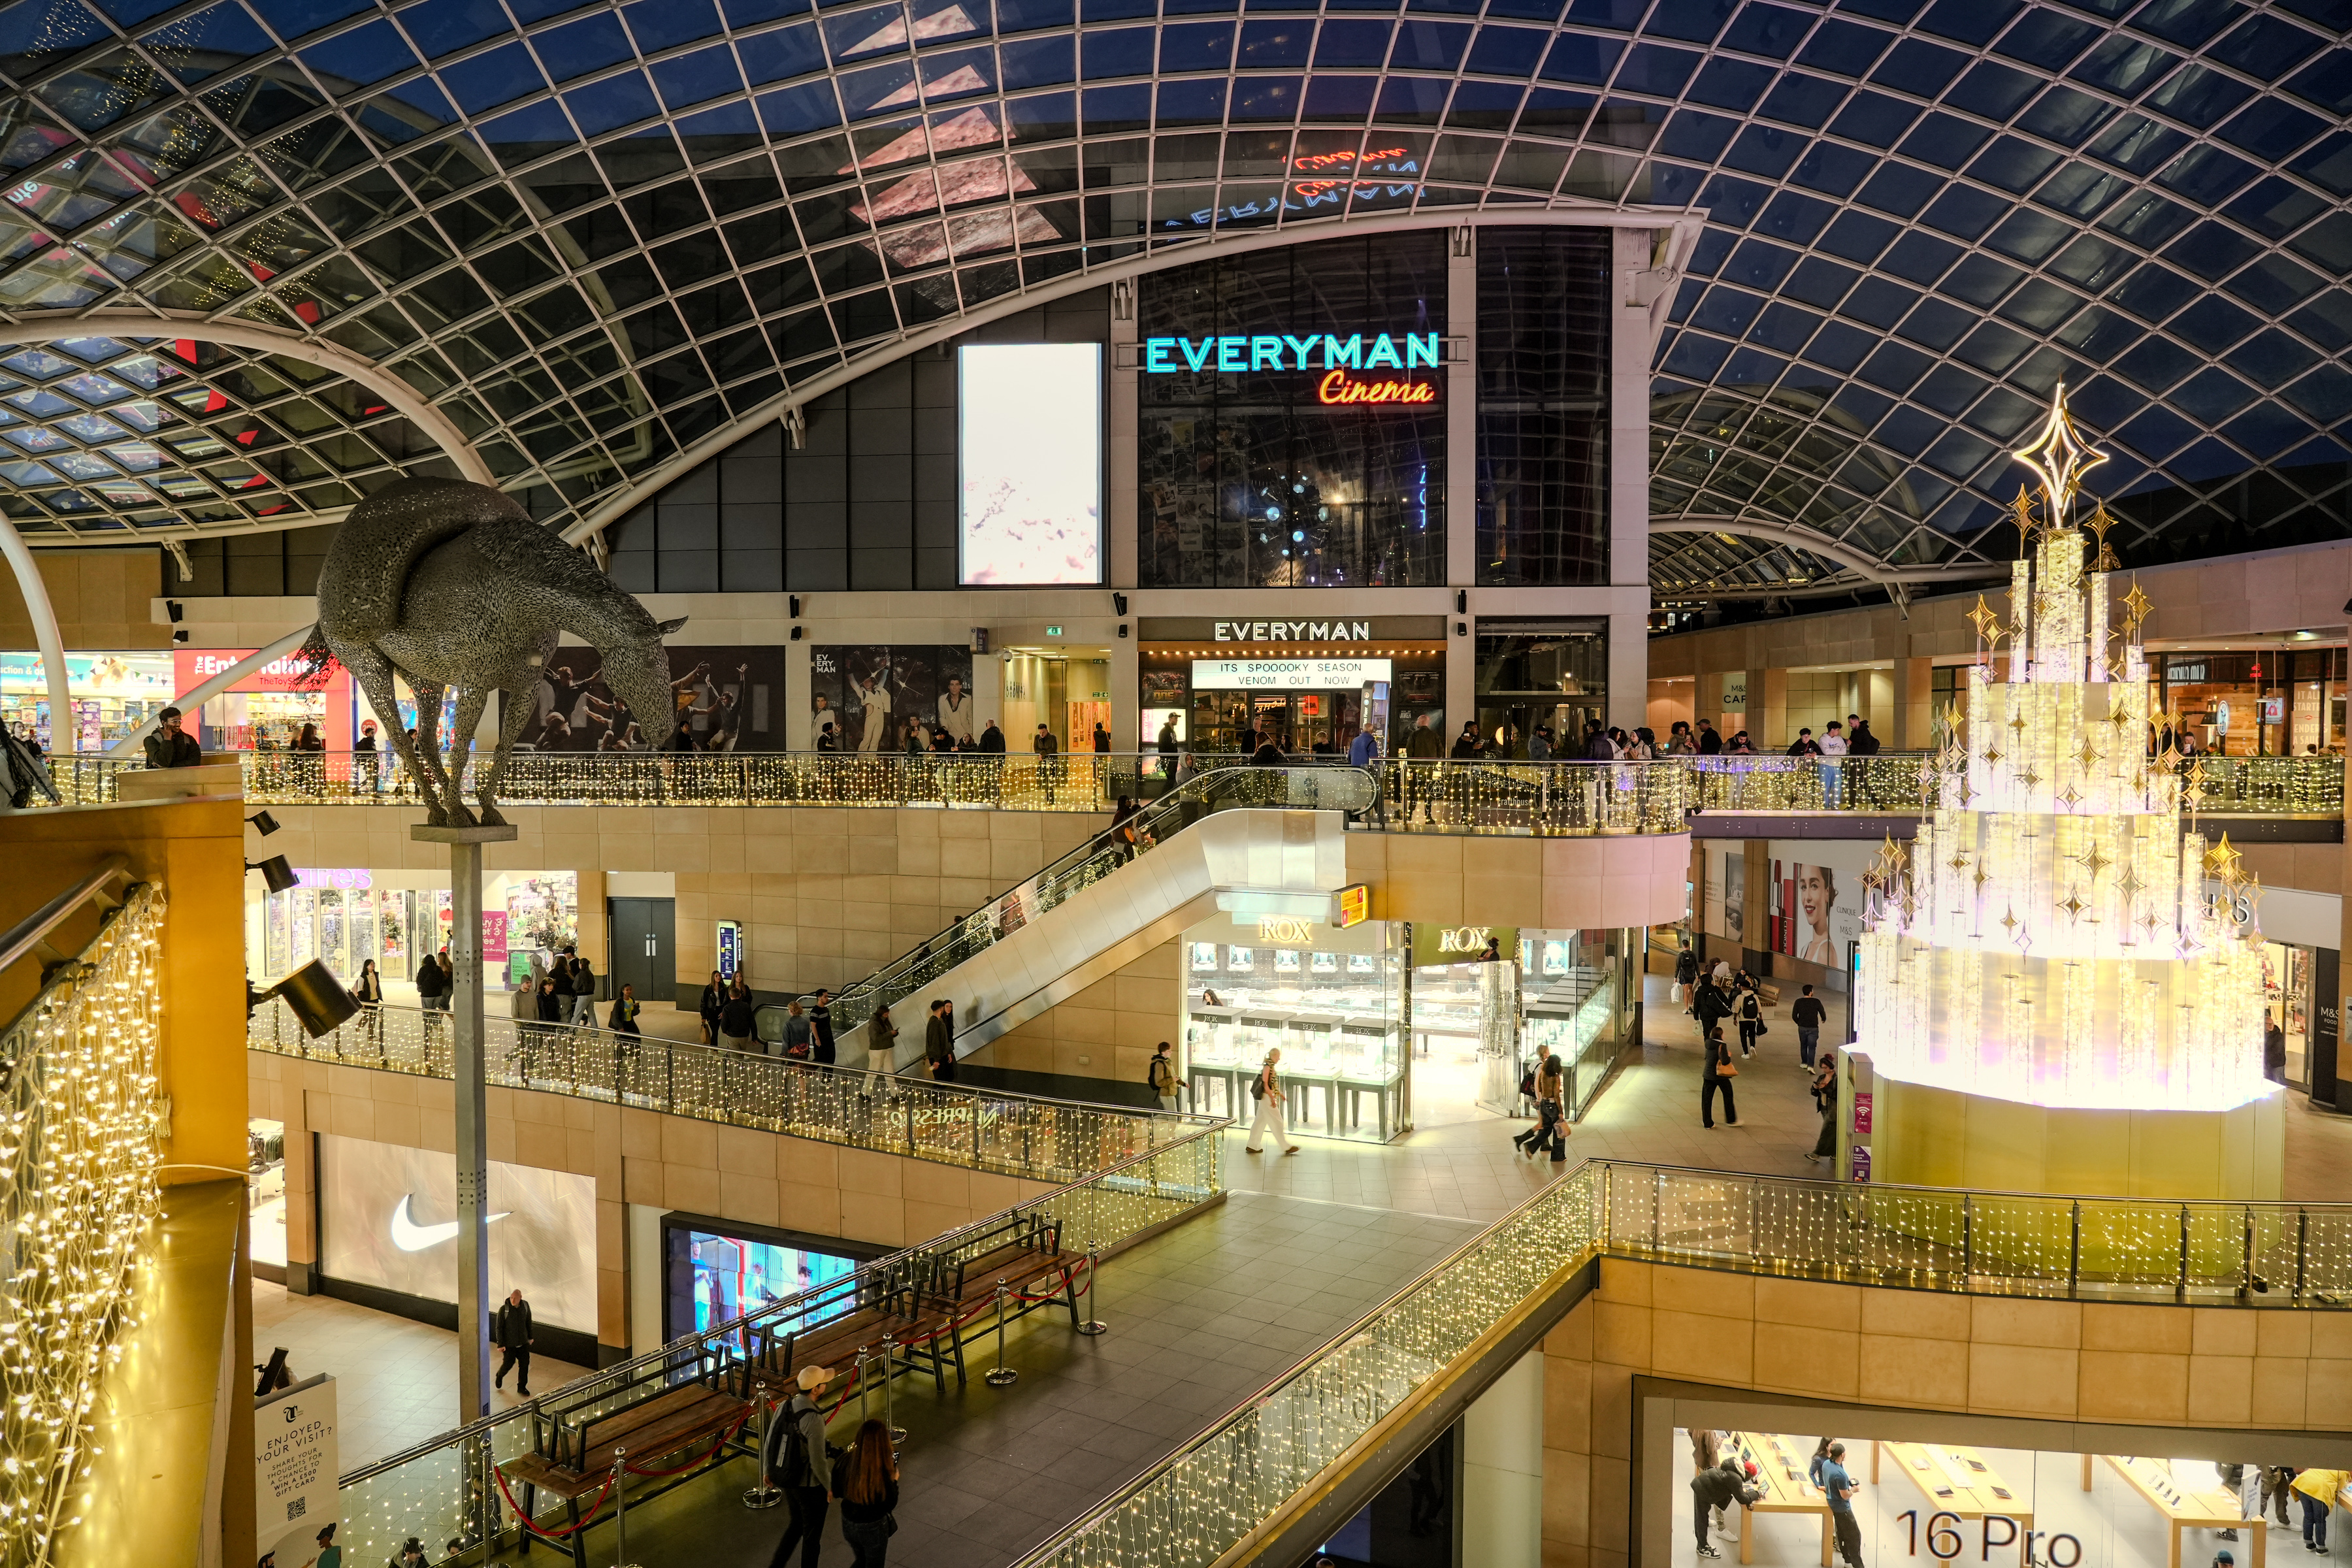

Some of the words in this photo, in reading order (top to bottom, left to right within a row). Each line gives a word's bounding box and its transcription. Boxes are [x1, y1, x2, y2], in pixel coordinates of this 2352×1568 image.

[1146, 332, 1438, 373] EVERYMAN
[1319, 370, 1435, 404] Cinema
[1215, 622, 1369, 641] EVERYMAN
[195, 656, 203, 674] The
[205, 655, 321, 674] Entaine
[1220, 664, 1238, 672] ITS
[1248, 663, 1309, 672] SPOOOOKY
[1317, 663, 1362, 672] SEASON
[1238, 676, 1277, 685] VENOM
[1289, 676, 1311, 685] OUT
[1324, 676, 1350, 685] NOW
[1154, 691, 1174, 700] ONE
[1723, 695, 1746, 704] CAF
[2298, 691, 2305, 700] IT
[2294, 702, 2326, 711] STARTE
[2294, 724, 2319, 733] ENDER
[2300, 736, 2320, 745] SAUC
[292, 868, 371, 889] aire's
[1837, 906, 1857, 916] CLINIQUE
[496, 917, 502, 926] 3
[494, 927, 501, 936] 3
[1259, 917, 1313, 943] ROX
[1840, 926, 1853, 936] M&S
[1437, 926, 1494, 953] ROX
[1204, 1015, 1218, 1023] ROX
[1254, 1019, 1268, 1028] ROX
[1302, 1023, 1316, 1032] ROX
[1355, 1026, 1371, 1036] ROX
[267, 1421, 321, 1449] ENJOYED
[256, 1445, 289, 1464] YOUR
[296, 1427, 332, 1447] VISIT?
[272, 1456, 295, 1471] SHARE
[298, 1448, 318, 1459] YOUR
[267, 1459, 306, 1480] THOUGHTS
[309, 1452, 322, 1462] FOR
[278, 1465, 308, 1482] CHANCE
[274, 1480, 289, 1490] WIN
[299, 1469, 316, 1480] £500
[276, 1486, 292, 1497] GIFT
[295, 1477, 315, 1489] CARD
[1896, 1510, 1963, 1560] 16
[1981, 1513, 2083, 1568] Pro
